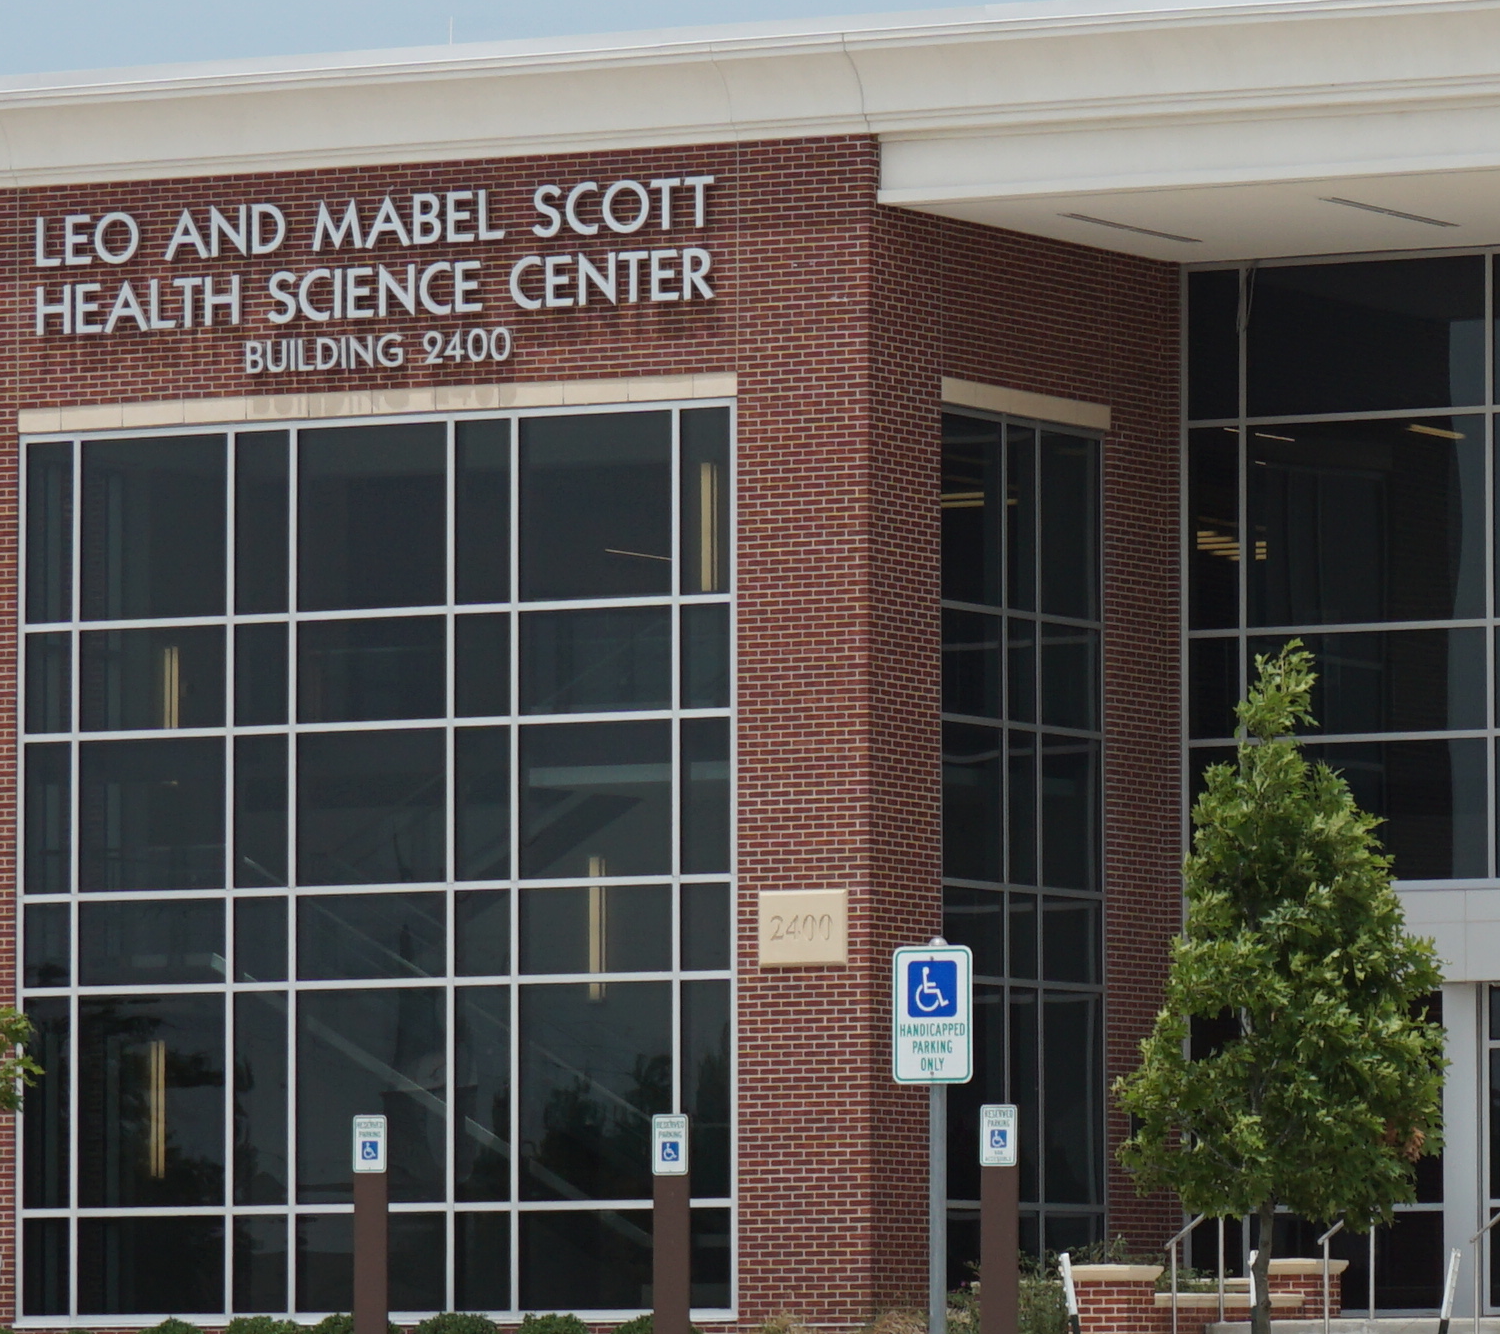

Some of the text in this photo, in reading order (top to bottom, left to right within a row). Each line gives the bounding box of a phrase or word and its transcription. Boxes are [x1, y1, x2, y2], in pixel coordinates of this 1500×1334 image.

[35, 175, 716, 267] LEO AND MABEL SCOTT
[35, 247, 717, 336] HEALTH SCIENCE CENTER
[245, 326, 513, 375] BUILDING 2400
[769, 913, 834, 942] 2400
[899, 1022, 966, 1037] HANDICAPPED
[912, 1040, 953, 1054] PARKING
[920, 1057, 945, 1071] ONLY
[984, 1109, 1014, 1118] RESERVED
[987, 1119, 1011, 1127] PARKING
